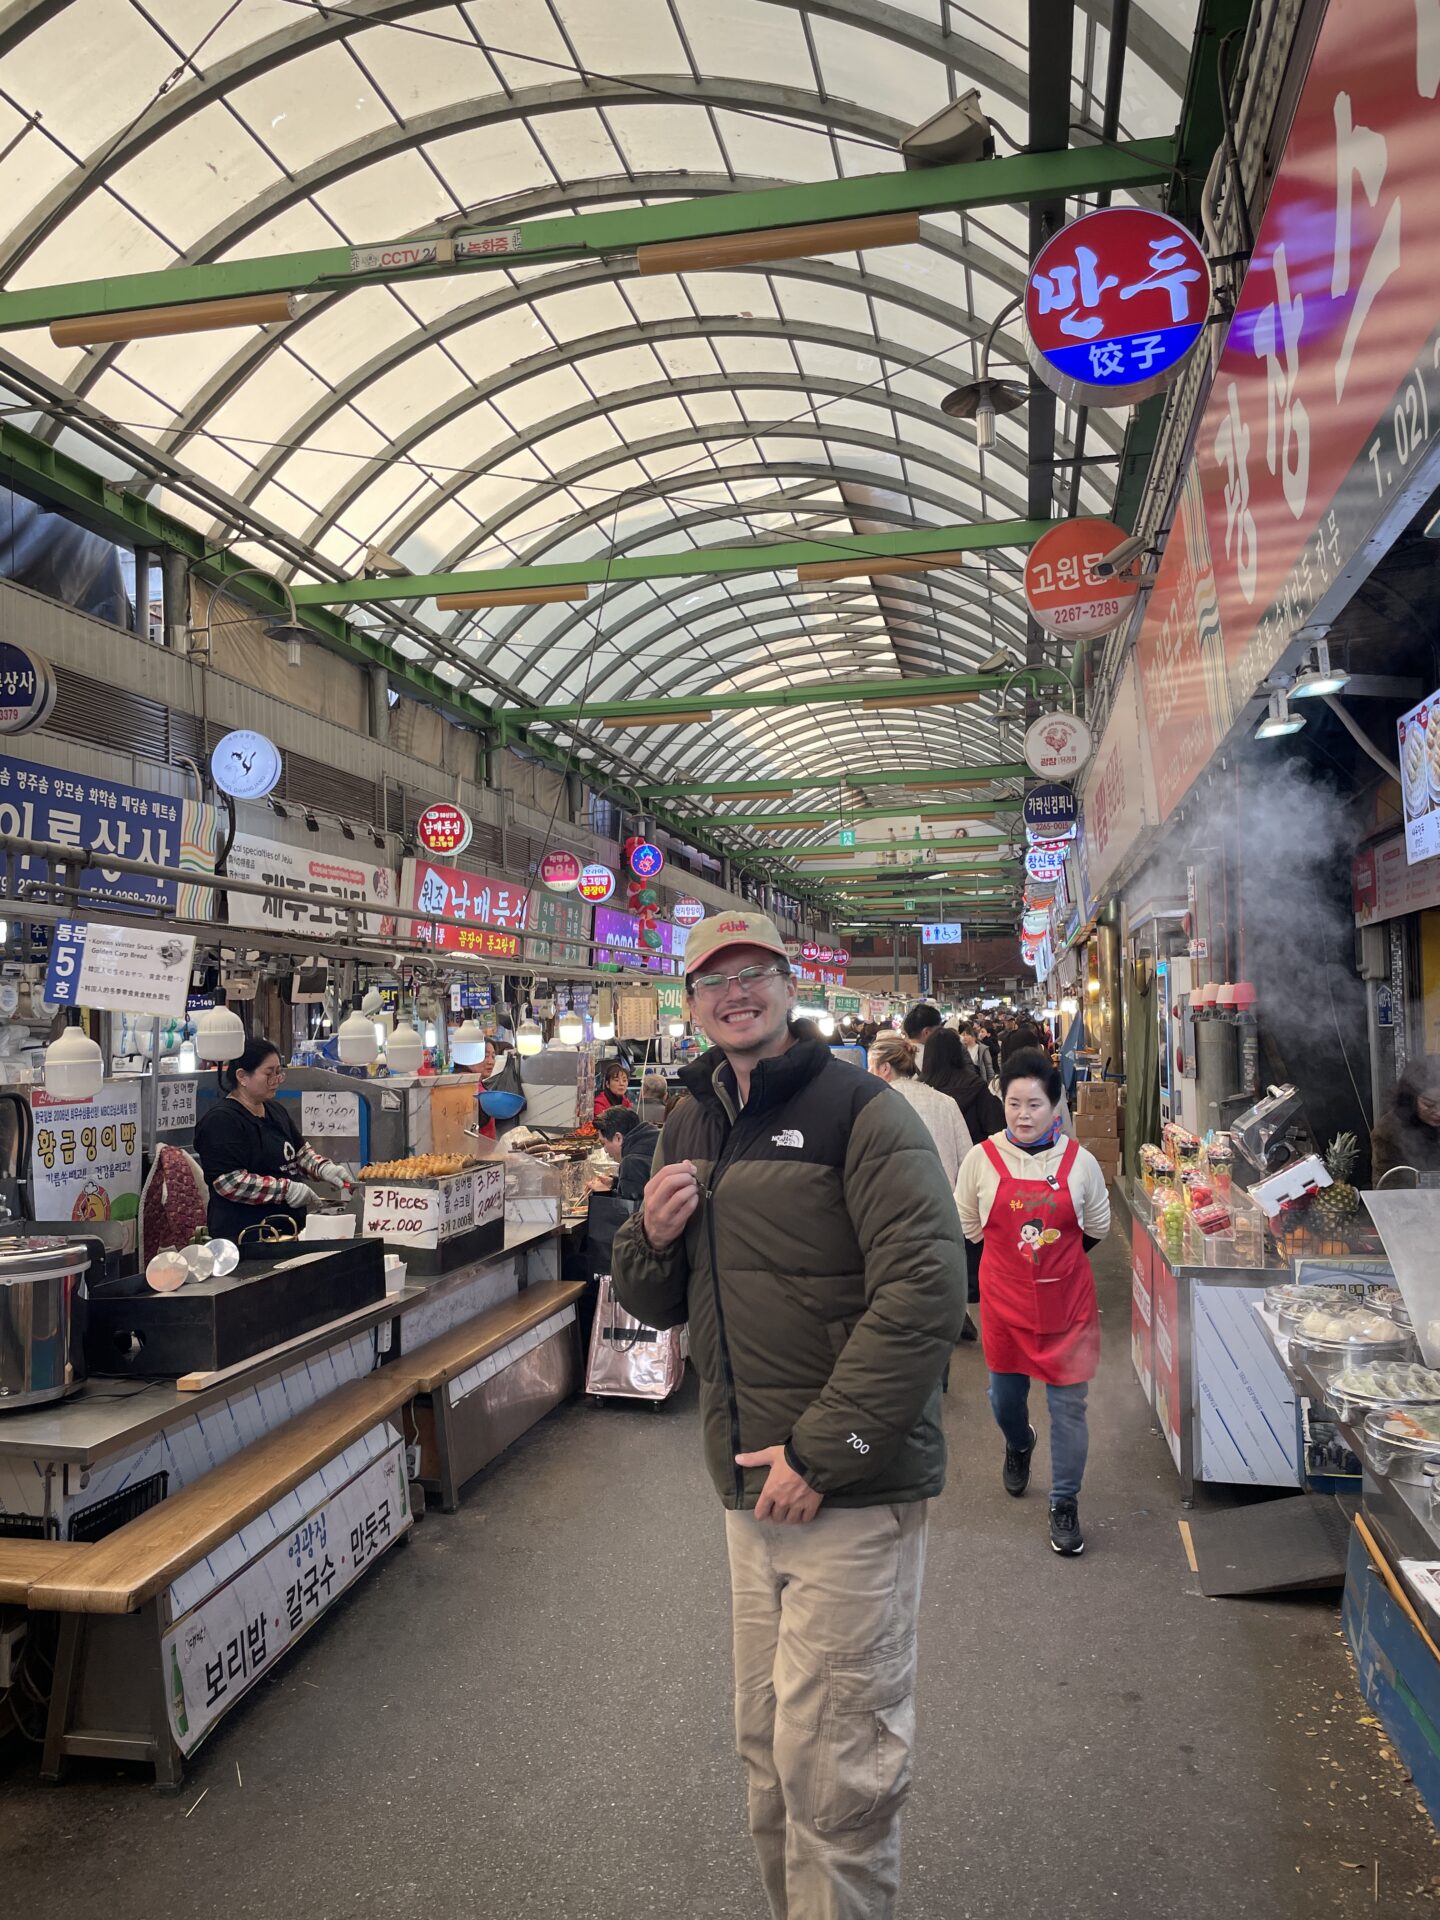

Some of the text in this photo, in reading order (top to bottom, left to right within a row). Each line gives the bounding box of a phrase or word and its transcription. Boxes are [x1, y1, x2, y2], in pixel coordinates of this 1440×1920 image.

[381, 249, 419, 266] CCTV
[467, 237, 509, 253] 녹화중
[1032, 235, 1201, 340] 만두
[1088, 334, 1166, 378] 饺子
[1394, 367, 1429, 465] 02)
[1031, 552, 1109, 595] 고원문
[1054, 600, 1119, 624] 2267-2289
[16, 771, 49, 794] 명주솜
[54, 779, 84, 802] 양모솜
[89, 787, 118, 809] 화학솜
[121, 795, 148, 816] 패딩솜
[152, 802, 177, 822] 매트솜
[1028, 795, 1074, 816] 카라신컴퍼니
[424, 821, 460, 835] 남매등심
[243, 845, 274, 860] specialties
[274, 853, 281, 861] of
[421, 879, 443, 912] 원조
[56, 924, 88, 944] 동문
[55, 947, 77, 977] 5
[114, 950, 129, 958] Carp
[130, 952, 148, 960] Bread
[53, 980, 70, 1000] 호
[372, 1191, 429, 1211] 3 Pieces
[846, 1433, 870, 1455] 700
[288, 1511, 327, 1568] 영광집
[205, 1498, 391, 1709] 보리밥 칼국수 만둣국
